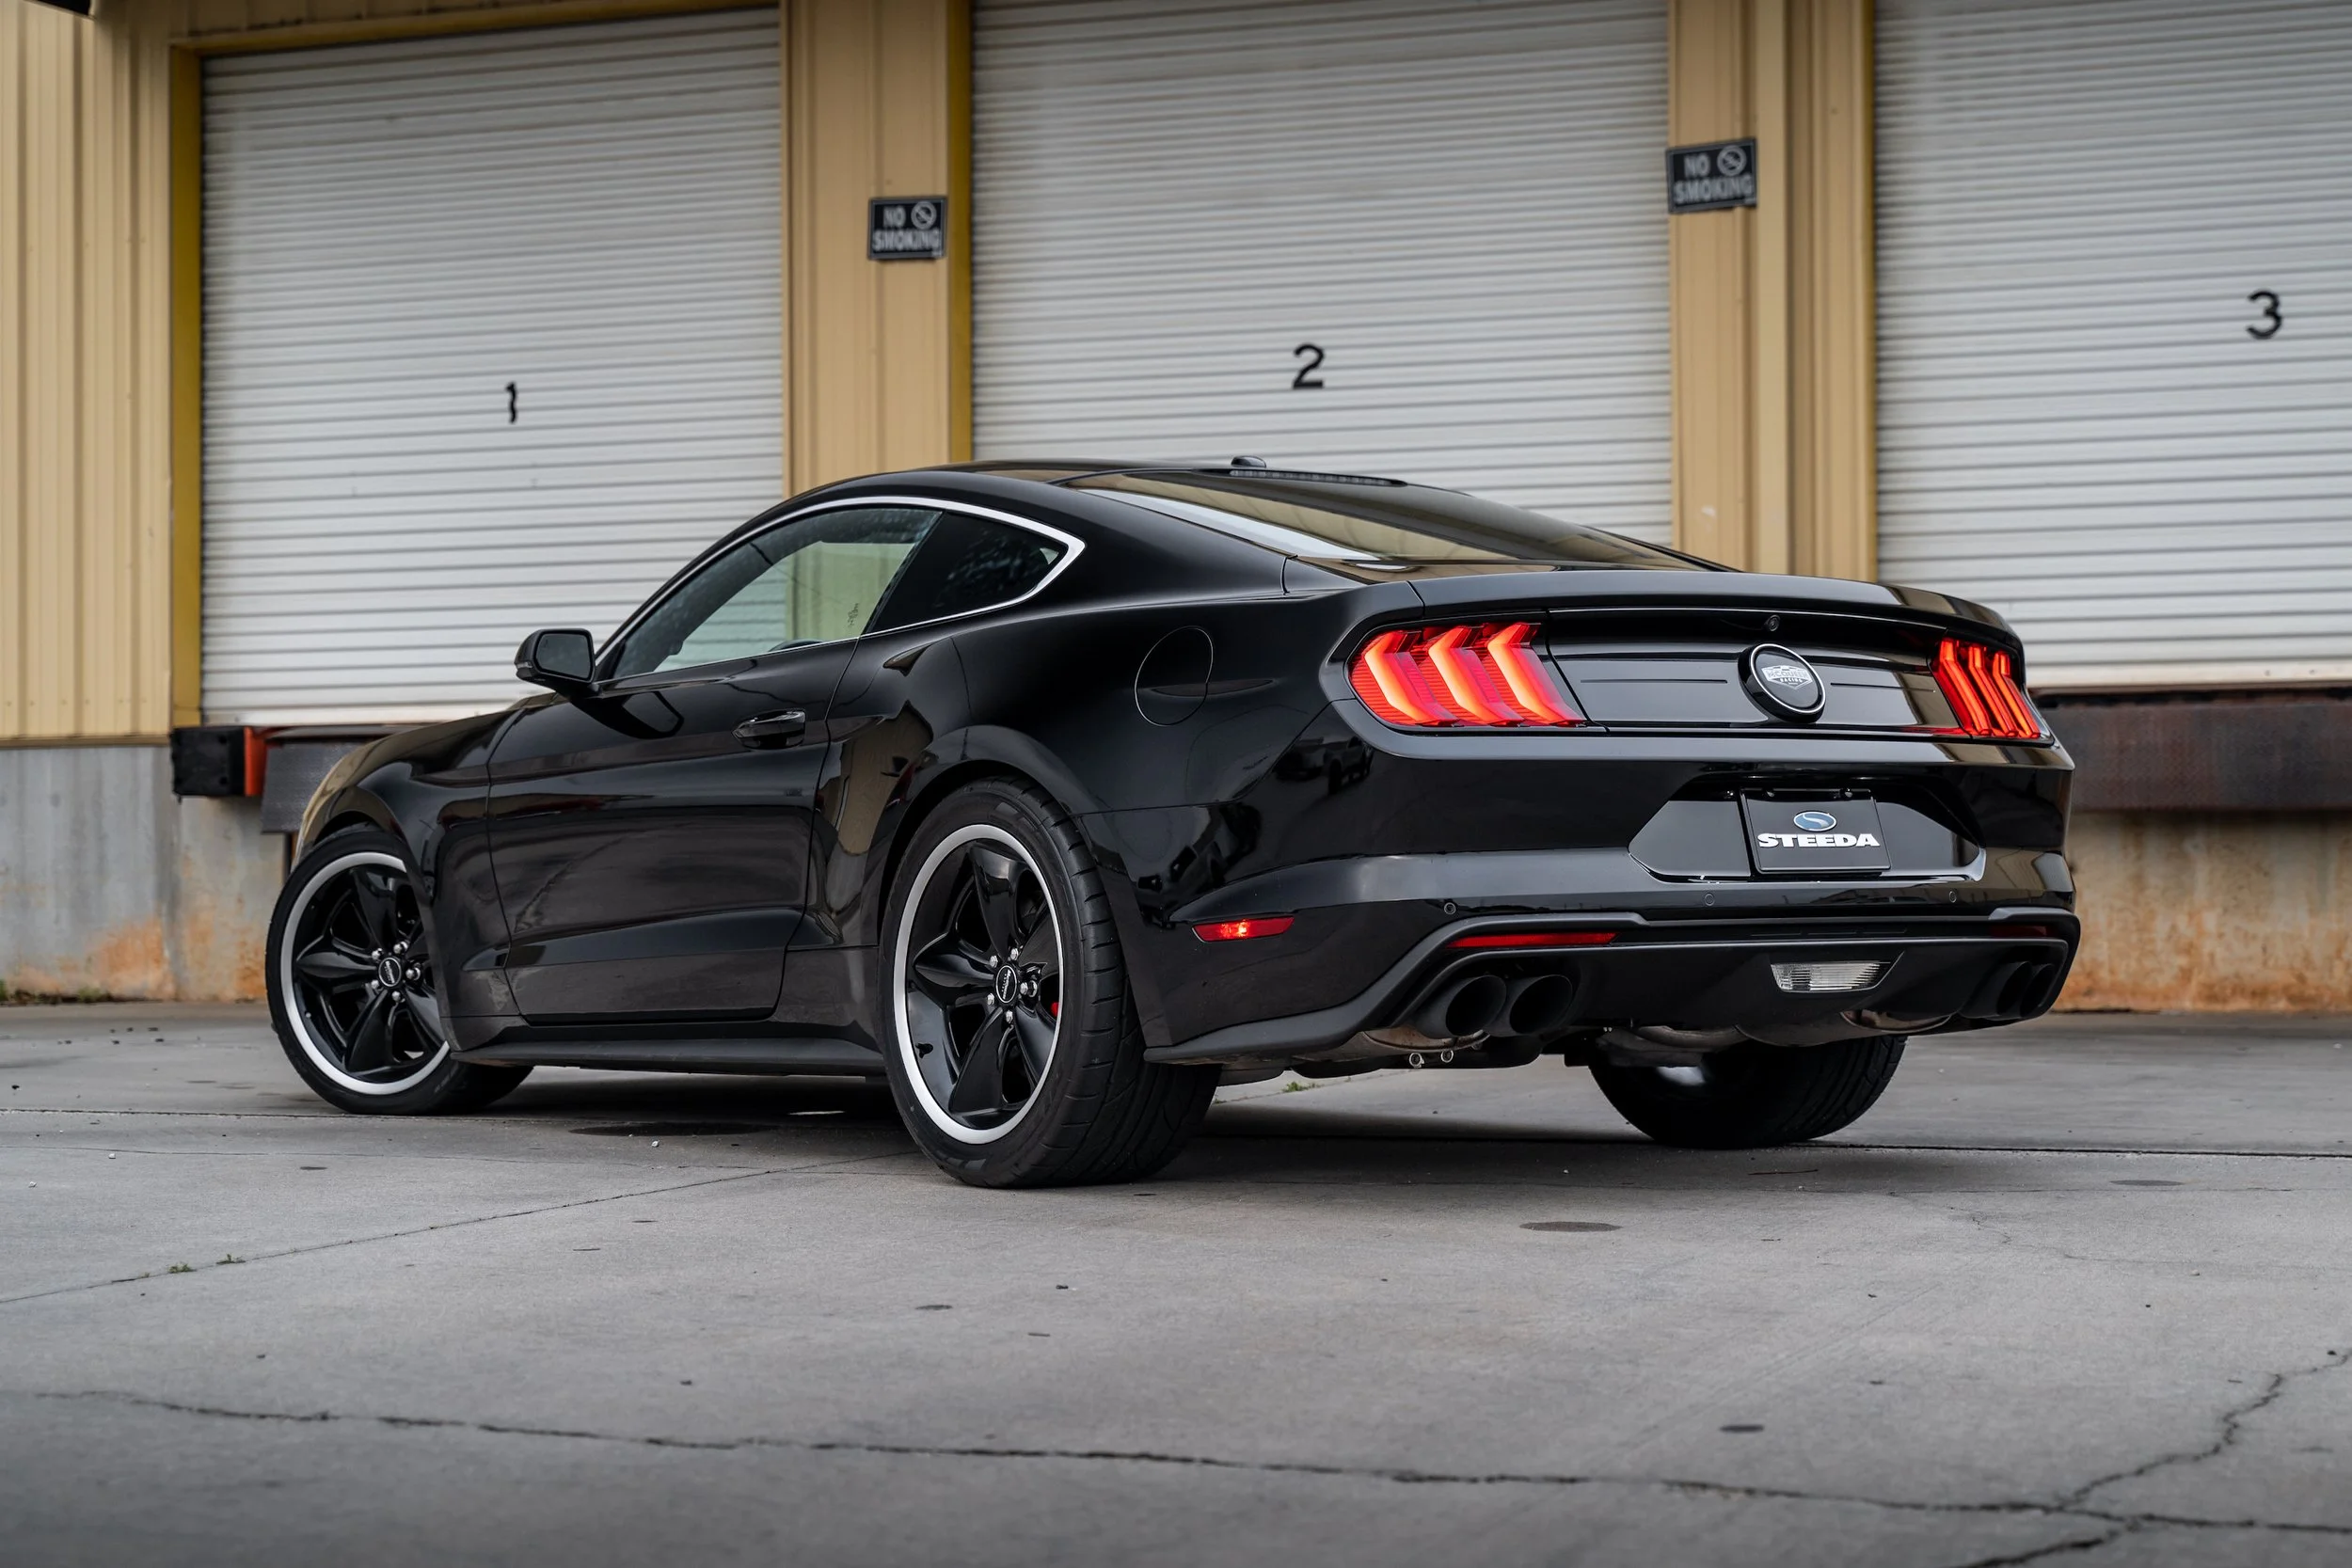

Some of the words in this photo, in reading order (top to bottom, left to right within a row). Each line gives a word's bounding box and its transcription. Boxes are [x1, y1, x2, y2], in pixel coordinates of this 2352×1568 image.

[1684, 153, 1710, 179] NO
[1674, 173, 1752, 204] SMOKING
[882, 206, 906, 227] NO
[872, 229, 940, 251] SMOKING
[2246, 290, 2281, 340] 3
[1293, 343, 1325, 389] 2
[505, 382, 516, 423] 1
[1757, 832, 1880, 847] STEEDA
